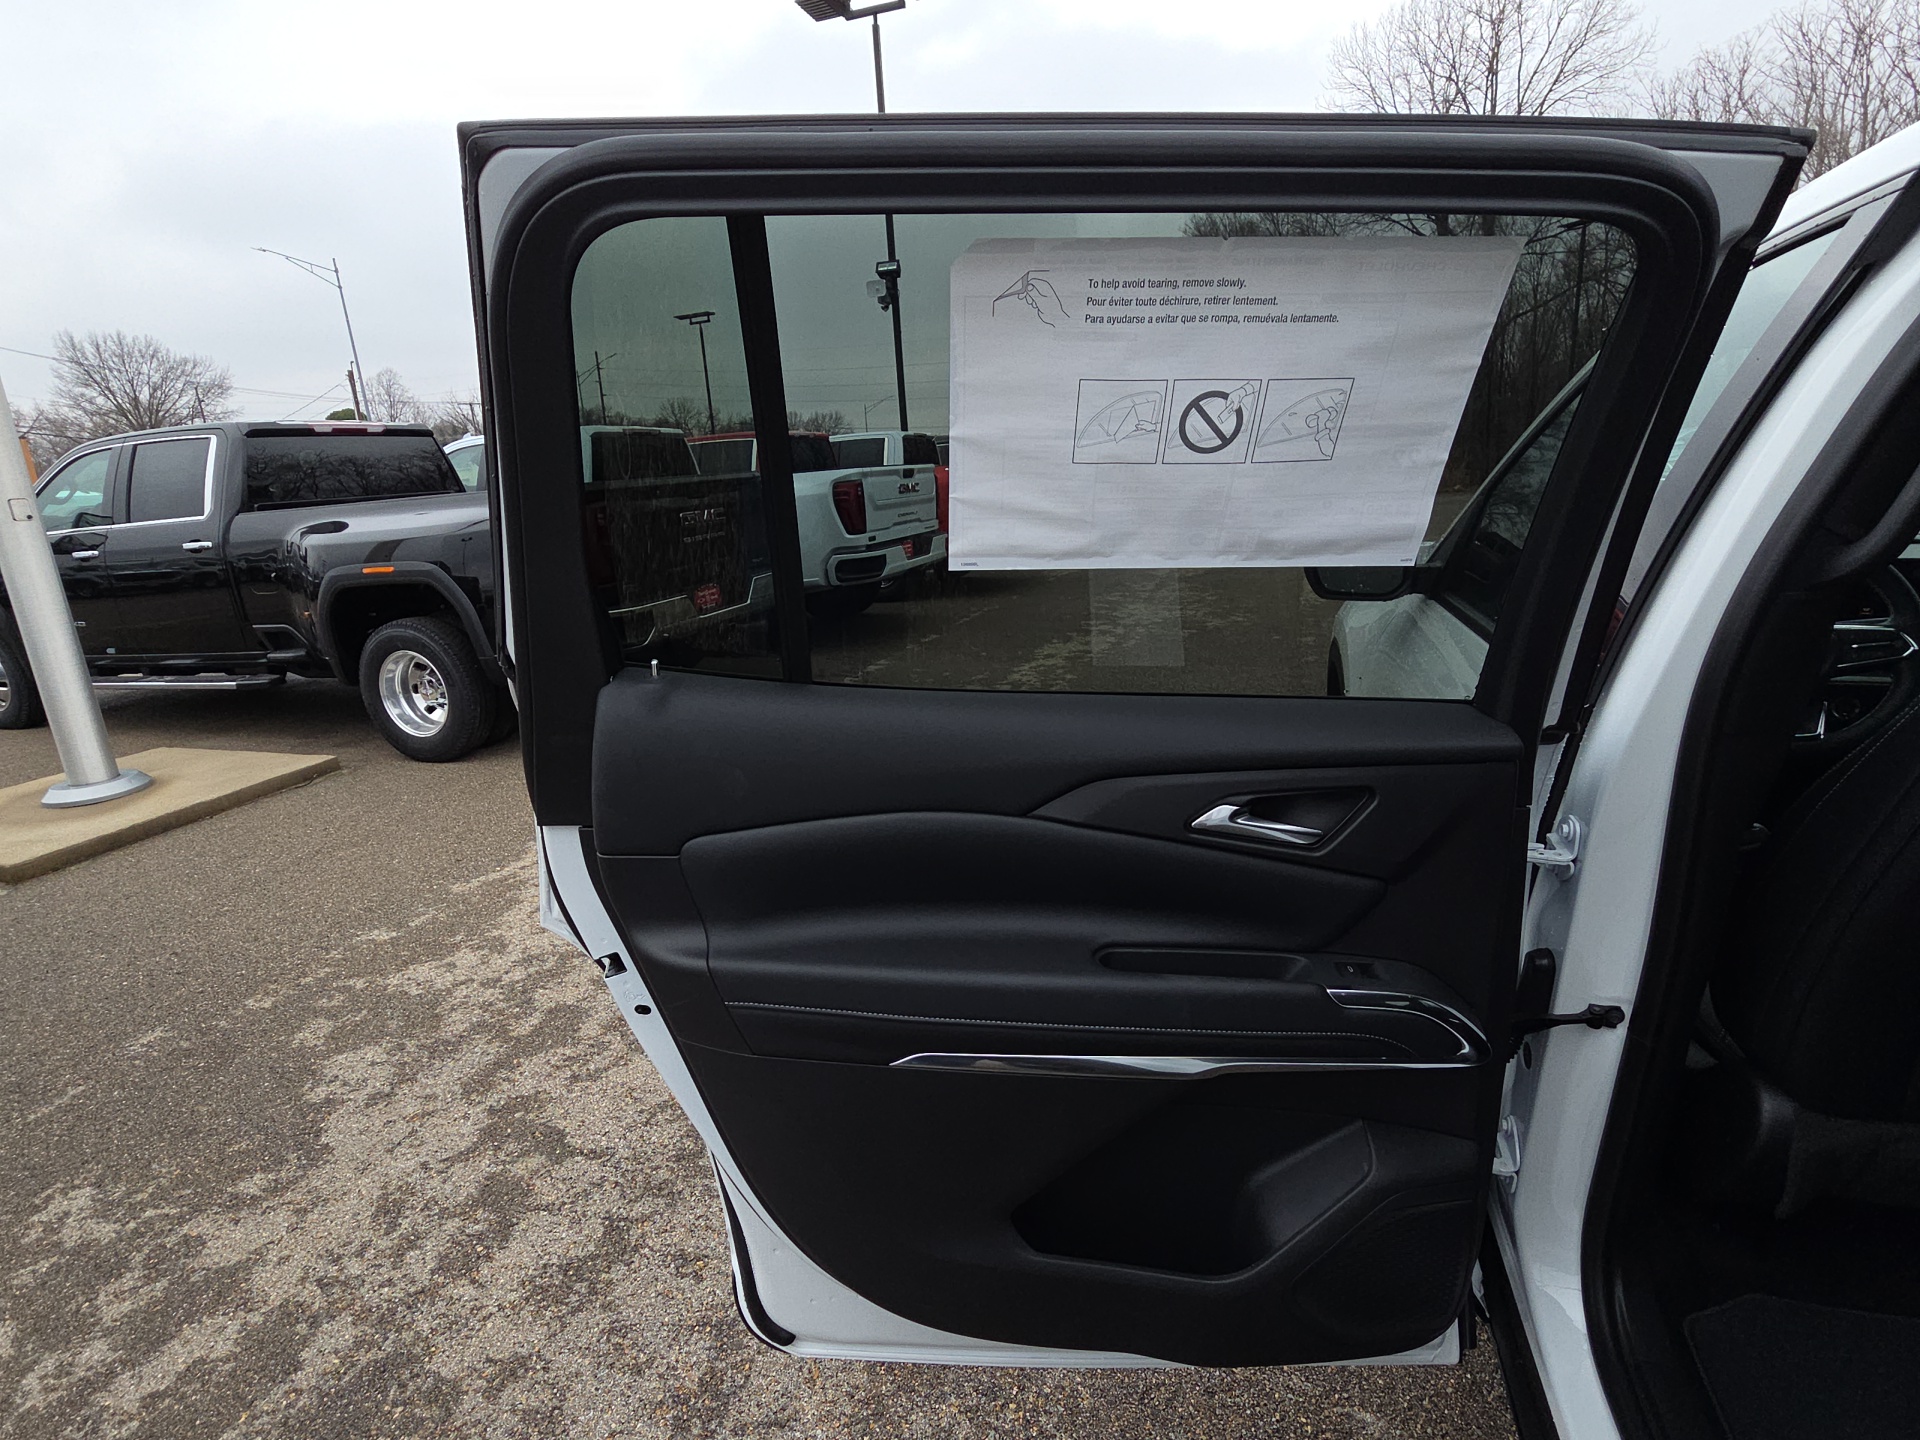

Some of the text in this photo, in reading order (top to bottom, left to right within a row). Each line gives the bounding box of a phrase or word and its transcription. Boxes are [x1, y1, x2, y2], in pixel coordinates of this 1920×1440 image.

[1088, 277, 1247, 290] To help avoid tearing, remove slowly.
[1086, 295, 1279, 307] Pour éviter toute déchirure, retirer lentement.
[1085, 312, 1339, 326] Para ayudarse a evitar que se rompa, remuévala lentamente.
[898, 482, 920, 494] GMC
[679, 508, 727, 527] GMC
